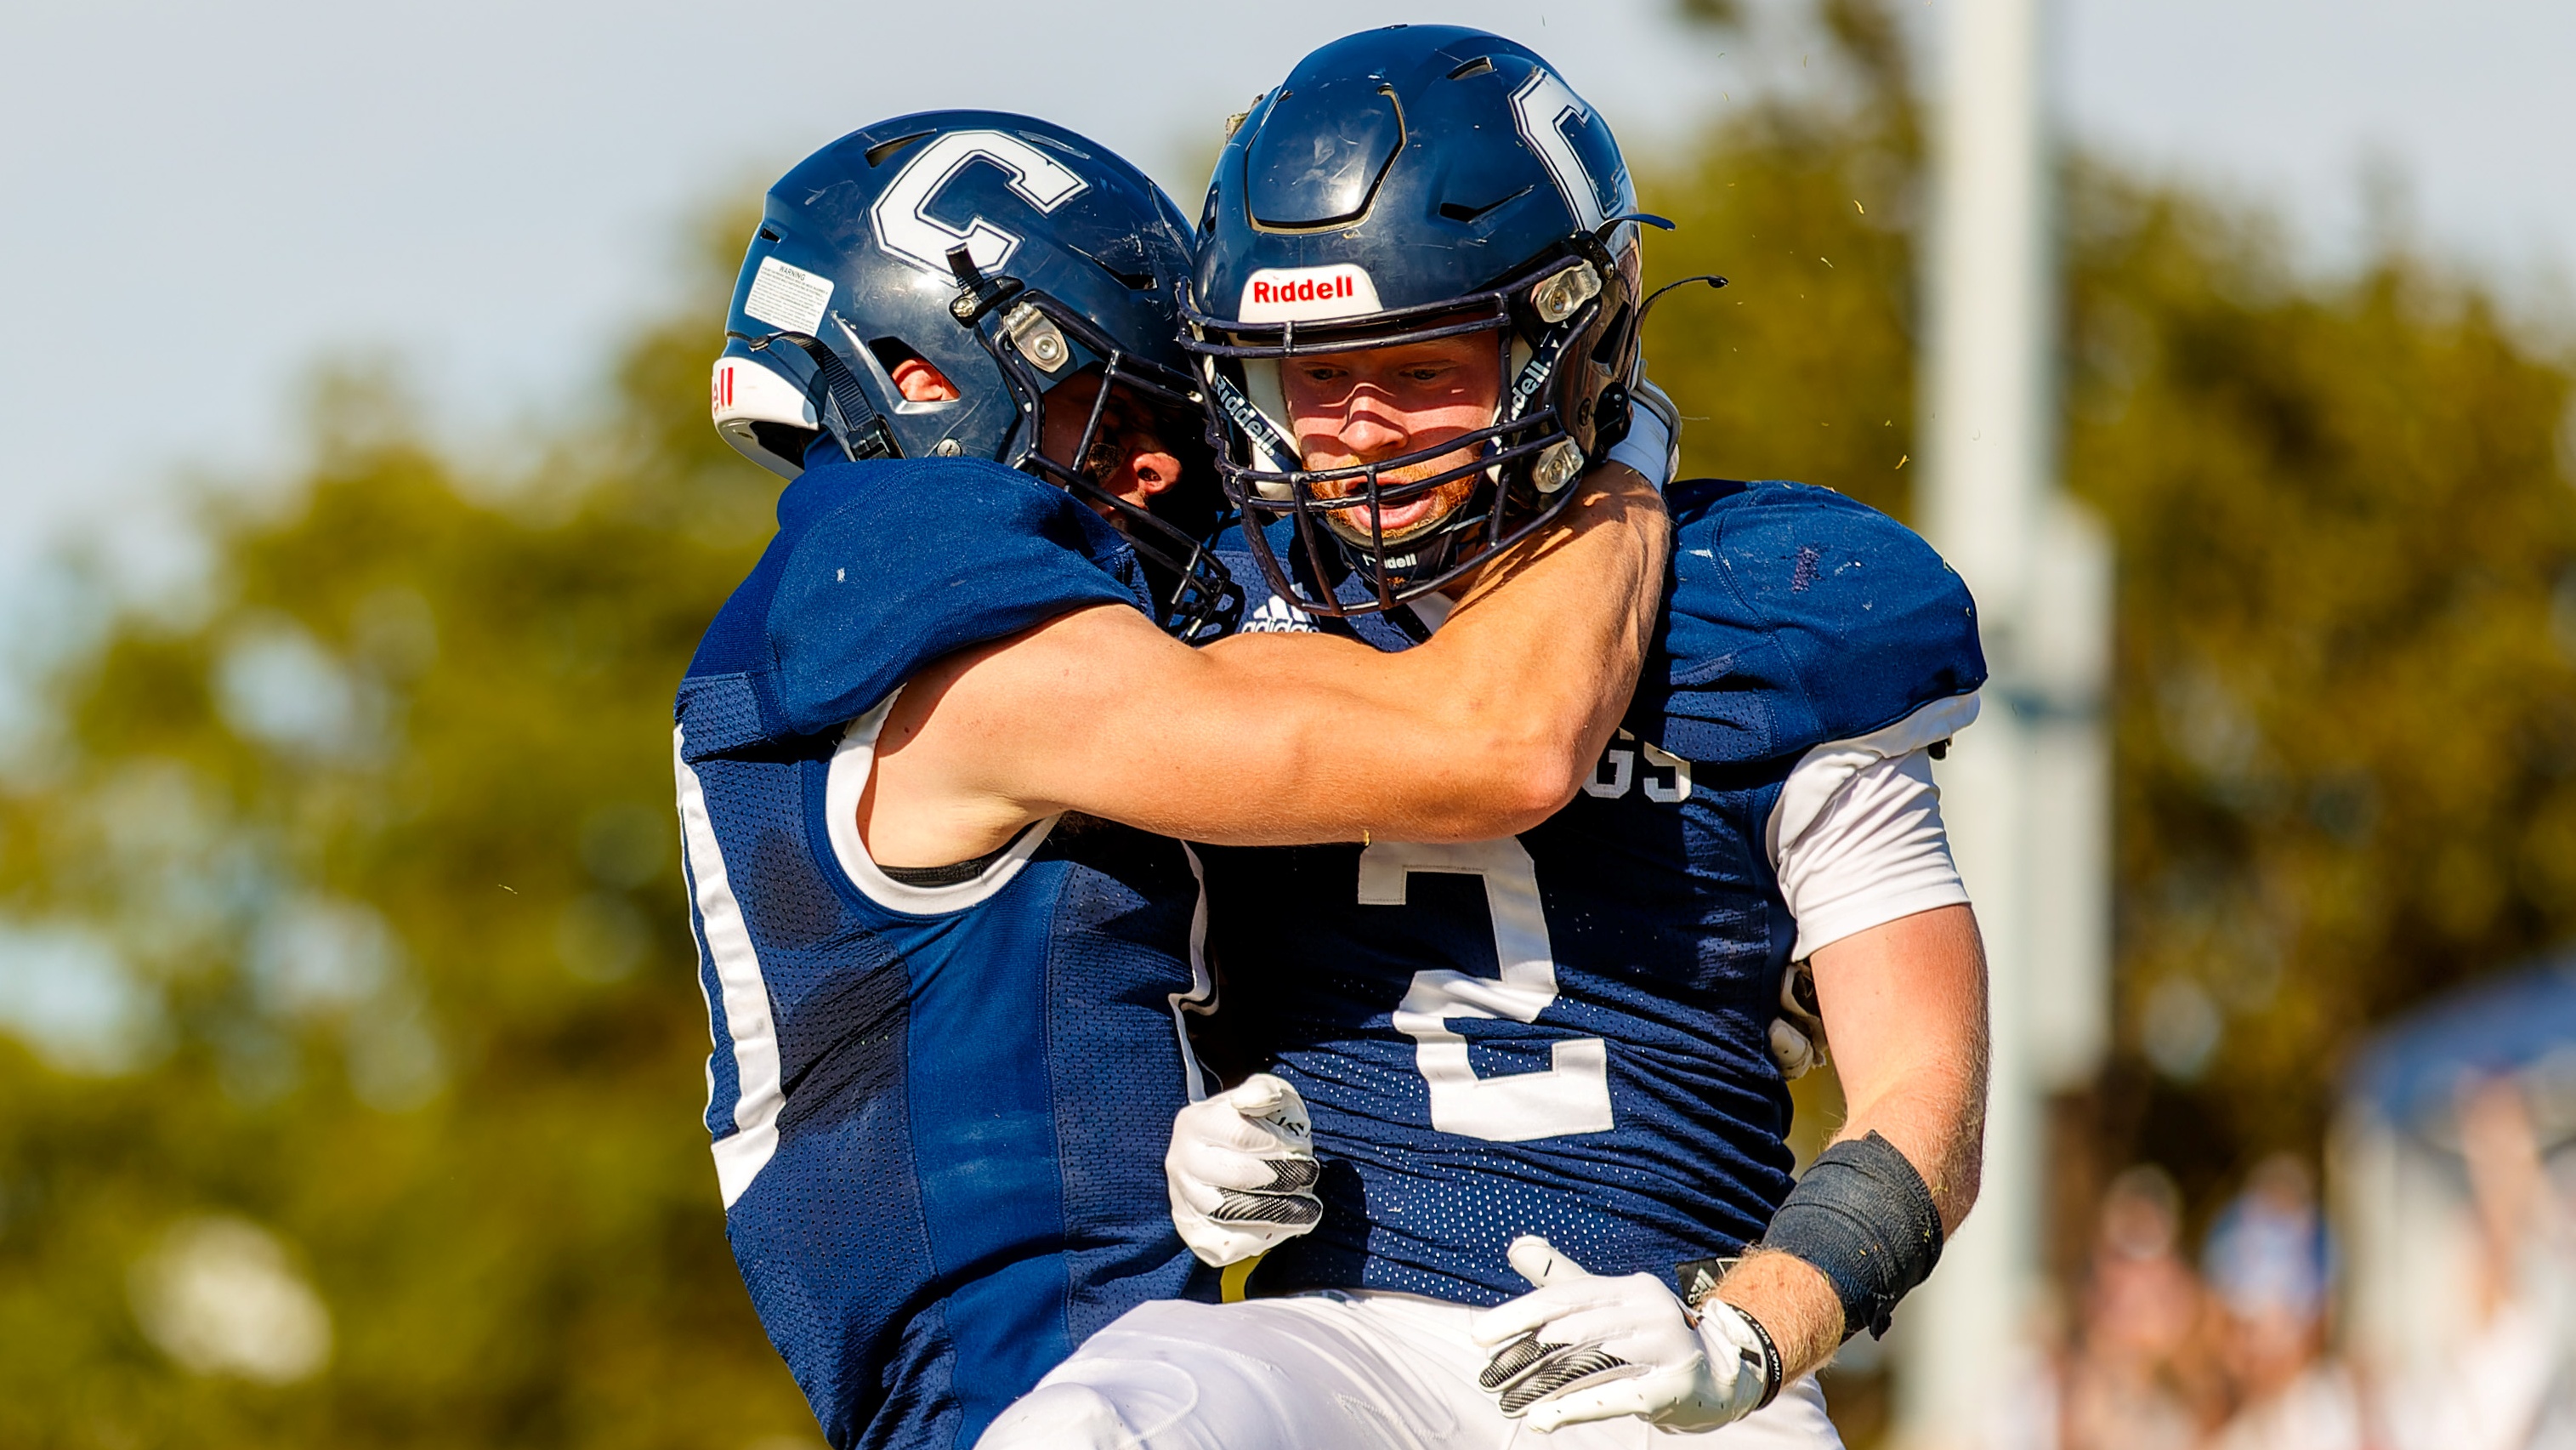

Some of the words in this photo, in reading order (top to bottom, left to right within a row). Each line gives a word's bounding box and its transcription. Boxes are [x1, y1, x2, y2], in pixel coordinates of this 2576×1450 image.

[869, 128, 1091, 287] C
[779, 265, 807, 281] WARNING
[1253, 275, 1353, 304] Riddell
[1215, 372, 1280, 452] Riddell
[1358, 836, 1614, 1141] 2
